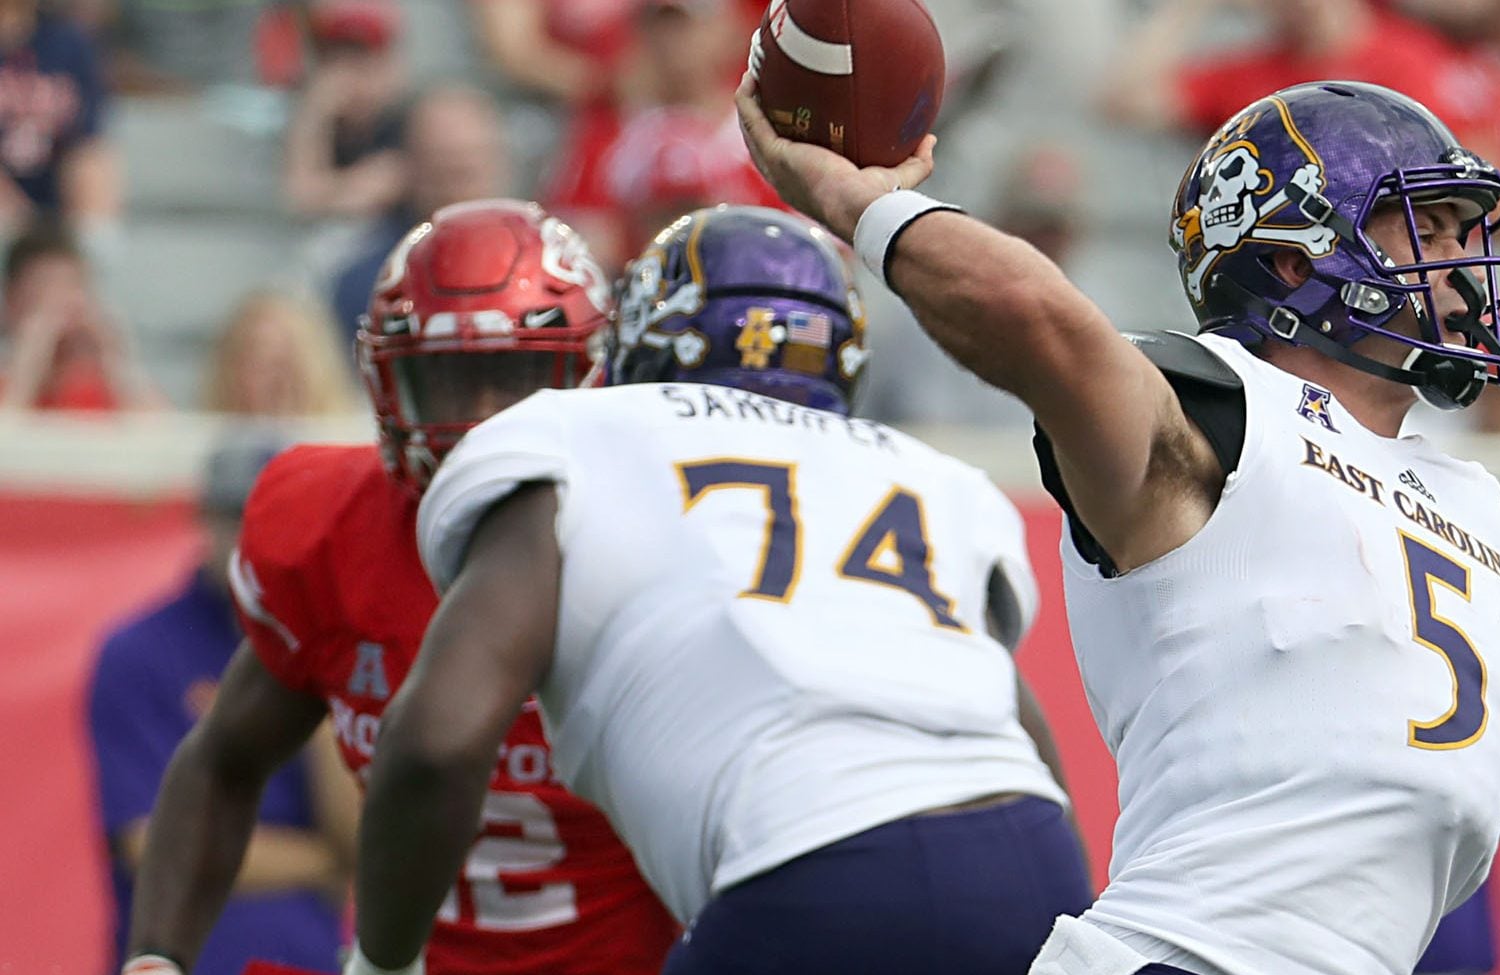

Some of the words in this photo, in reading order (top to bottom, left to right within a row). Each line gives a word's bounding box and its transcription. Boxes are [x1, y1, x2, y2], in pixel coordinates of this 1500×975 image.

[672, 454, 972, 635] 74
[1299, 434, 1387, 507] EAST
[1396, 526, 1489, 751] 5
